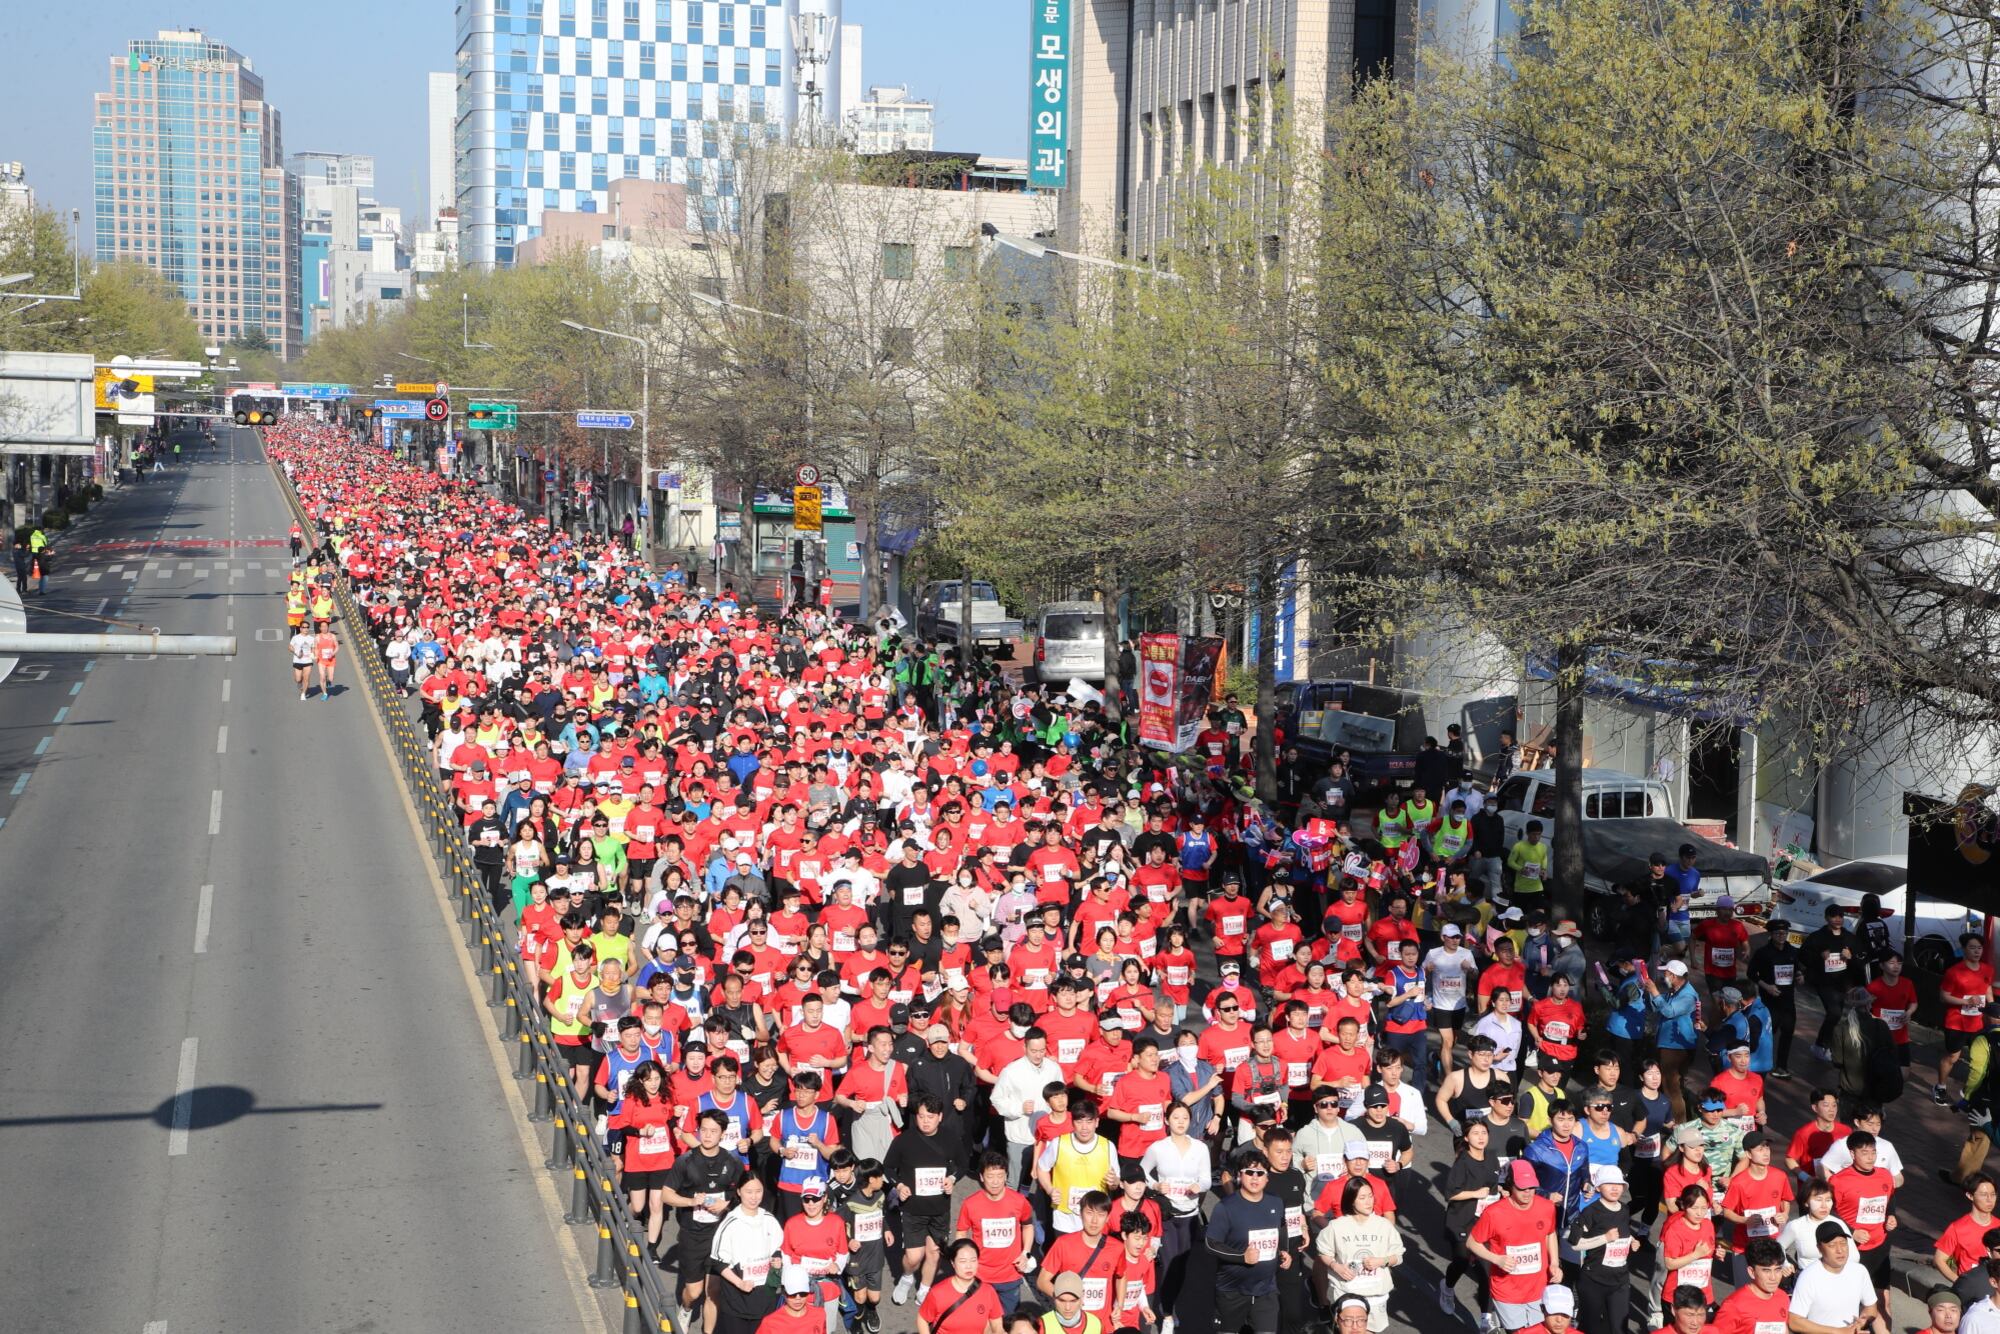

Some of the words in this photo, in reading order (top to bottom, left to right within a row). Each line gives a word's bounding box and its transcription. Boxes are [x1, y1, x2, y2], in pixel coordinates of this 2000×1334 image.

[151, 55, 224, 73] 우리들병원
[1035, 34, 1065, 177] 모생외과
[431, 405, 443, 415] 50
[801, 470, 814, 480] 50
[612, 1142, 622, 1153] 18
[792, 1150, 813, 1160] 0781
[984, 1228, 1012, 1238] 14701
